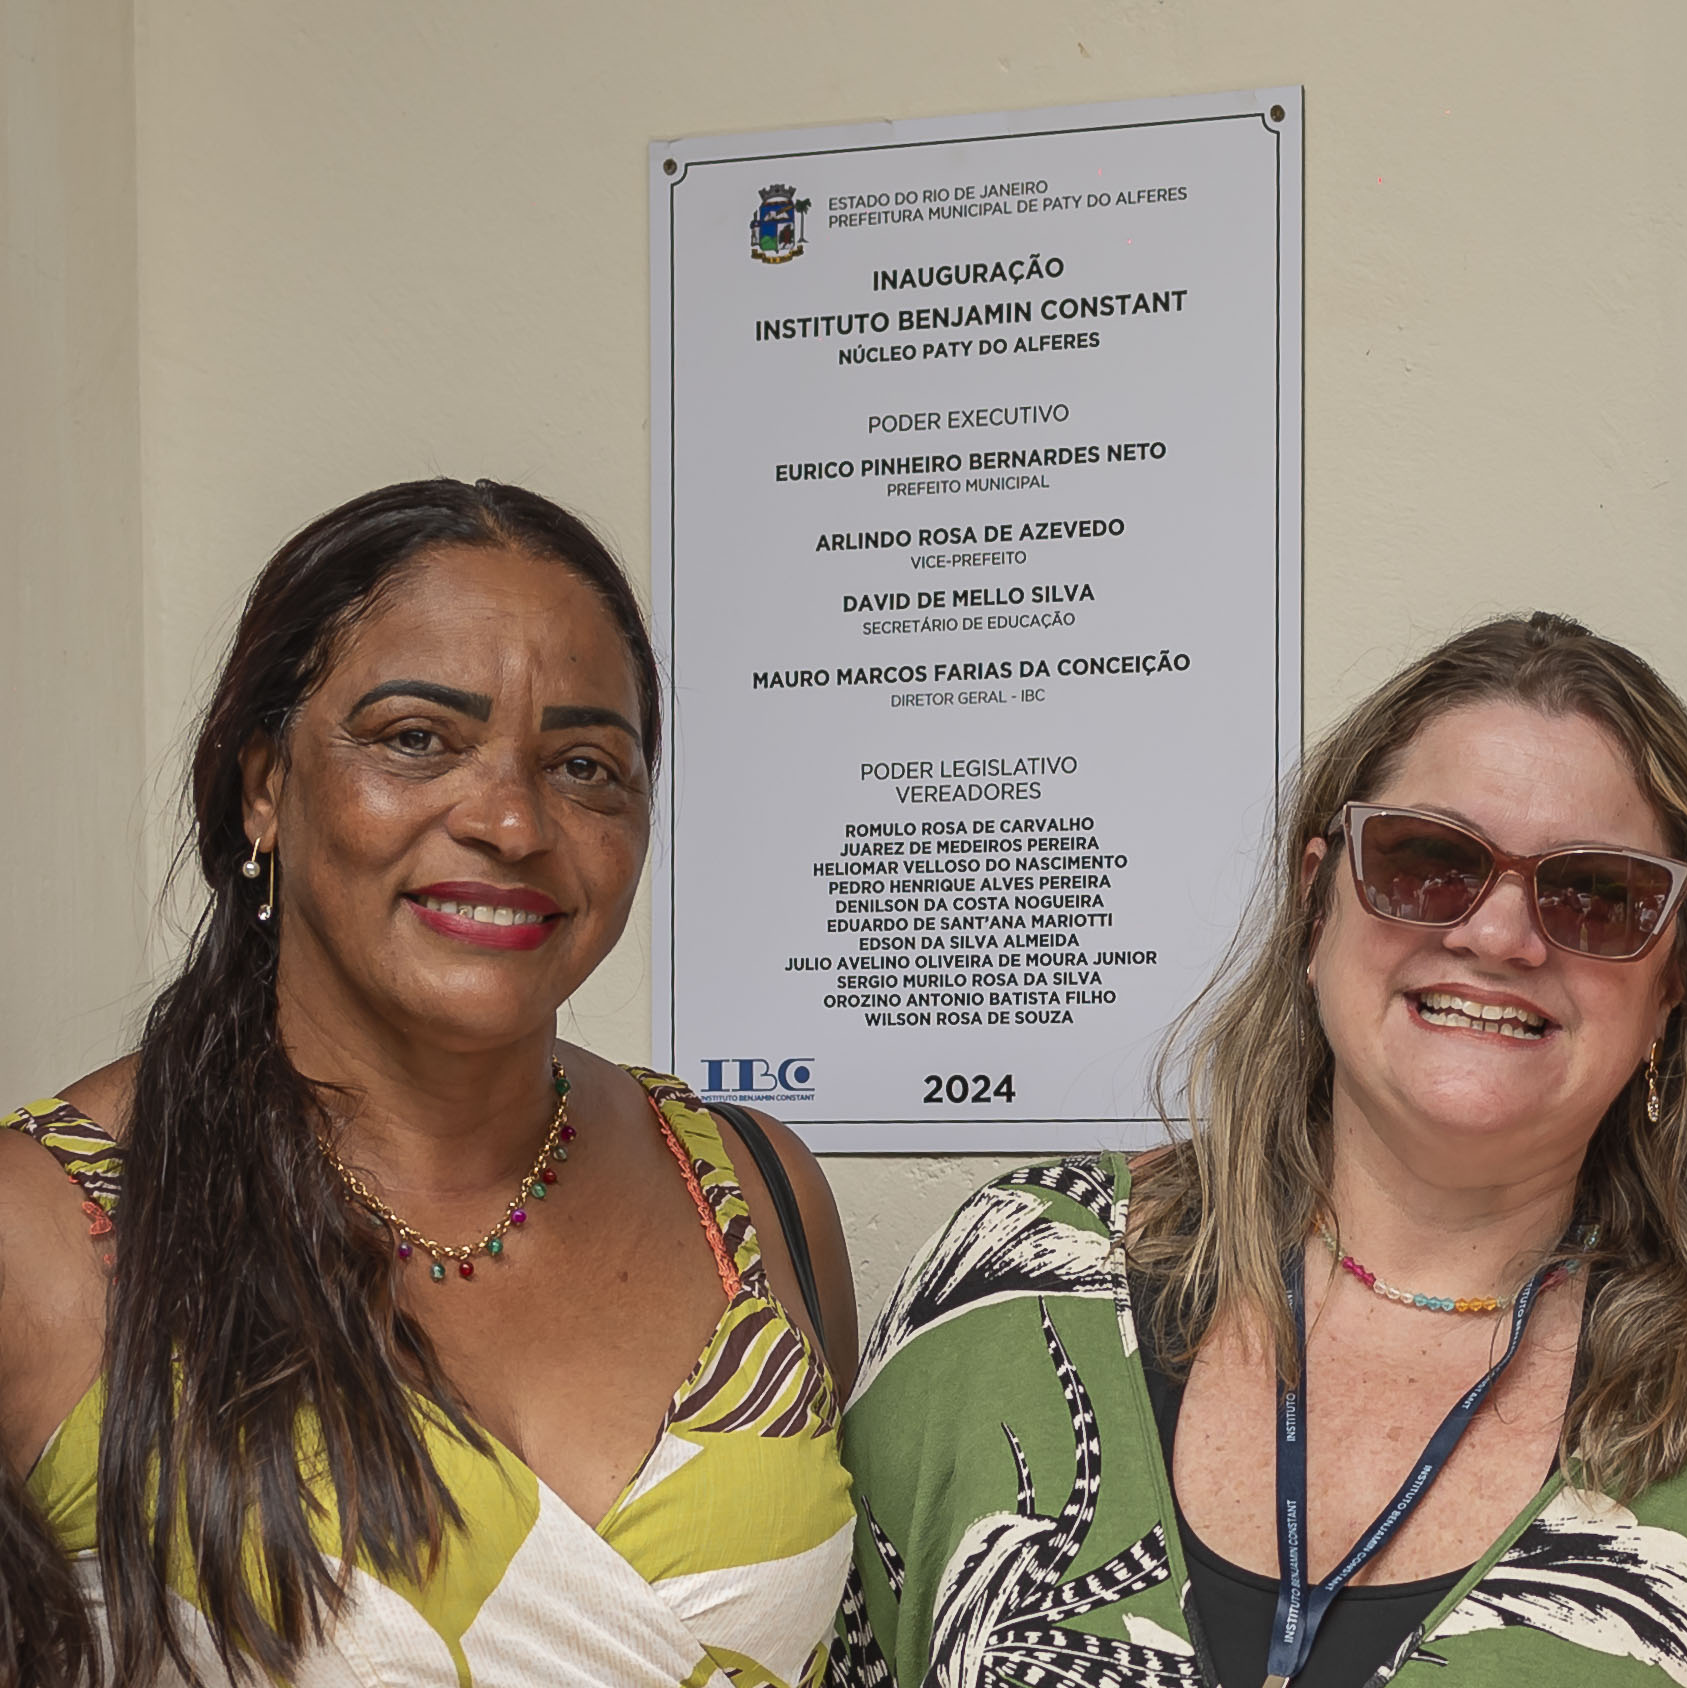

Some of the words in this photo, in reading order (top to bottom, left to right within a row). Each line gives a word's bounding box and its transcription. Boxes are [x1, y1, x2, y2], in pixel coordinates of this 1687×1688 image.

[828, 192, 891, 212] ESTADO
[894, 190, 919, 207] DO
[922, 187, 950, 204] RIO
[954, 185, 976, 201] DE
[979, 179, 1049, 199] JANEIRO
[828, 207, 925, 229] PREFEITURA
[928, 200, 1013, 221] MUNICIPAL
[1016, 197, 1039, 214] DE
[1042, 194, 1083, 212] PATY
[1086, 192, 1112, 208] DO
[1115, 186, 1188, 206] ALFERES
[873, 253, 1065, 292] INAUGURAÇÃO
[755, 311, 890, 342] INSTITUTO
[898, 300, 1032, 332] BENJAMIN
[1040, 289, 1188, 321] CONSTANT
[838, 343, 917, 366] NÚCLEO
[922, 339, 974, 360] PATY
[978, 338, 1008, 356] DO
[1012, 331, 1101, 354] ALFERES
[868, 412, 942, 435] PODER
[947, 403, 1070, 430] EXECUTIVO
[775, 460, 855, 483] EURICO
[860, 453, 962, 478] PINHEIRO
[968, 445, 1101, 471] BERNARDES
[1107, 441, 1167, 463] NETO
[886, 479, 962, 498] PREFEITO
[965, 474, 1050, 493] MUNICIPAL
[815, 529, 912, 553] ARLINDO
[918, 525, 978, 547] ROSA
[984, 523, 1013, 544] DE
[1018, 518, 1125, 542] AZEVEDO
[910, 550, 1027, 570] VICE-PREFEITO
[843, 592, 911, 613] DAVID
[917, 590, 946, 610] DE
[952, 586, 1025, 608] MELLO
[1031, 583, 1096, 604] SILVA
[862, 615, 959, 636] SECRETÁRIO
[962, 615, 984, 631] DE
[987, 610, 1076, 630] EDUCAÇÃO
[752, 668, 830, 690] MAURO
[836, 664, 928, 687] MARCOS
[933, 660, 1013, 682] FARIAS
[1019, 659, 1051, 679] DA
[1056, 650, 1191, 677] CONCEIÇÃO
[890, 692, 955, 708] DIRETOR
[957, 689, 1008, 705] GERAL
[1020, 688, 1046, 703] IBC
[860, 761, 934, 782] PODER
[940, 755, 1078, 779] LEGISLATIVO
[895, 781, 1042, 804] VEREADORES
[845, 821, 917, 839] ROMULO
[921, 820, 968, 837] ROSA
[972, 819, 996, 835] DE
[999, 816, 1095, 834] CARVALHO
[839, 841, 905, 858] JUAREZ
[909, 840, 933, 856] DE
[936, 838, 1023, 855] MEDEIROS
[1027, 835, 1100, 852] PEREIRA
[813, 860, 899, 877] HELIOMAR
[902, 858, 981, 875] VELLOSO
[985, 857, 1011, 873] DO
[1015, 854, 1128, 872] NASCIMENTO
[828, 879, 886, 896] PEDRO
[889, 877, 976, 894] HENRIQUE
[979, 876, 1035, 892] ALVES
[1038, 874, 1112, 891] PEREIRA
[835, 897, 919, 914] DENILSON
[923, 896, 949, 912] DA
[952, 895, 1011, 912] COSTA
[1014, 893, 1105, 910] NOGUEIRA
[826, 917, 909, 933] EDUARDO
[913, 916, 937, 932] DE
[1031, 912, 1113, 929] MARIOTTI
[858, 935, 917, 952] EDSON
[920, 935, 946, 950] DA
[949, 934, 999, 950] SILVA
[1002, 932, 1080, 949] ALMEIDA
[784, 956, 833, 972] JULIO
[836, 955, 911, 971] AVELINO
[914, 953, 994, 970] OLIVEIRA
[998, 953, 1022, 968] DE
[1025, 951, 1089, 968] MOURA
[1092, 950, 1158, 966] JUNIOR
[836, 974, 899, 990] SERGIO
[902, 973, 968, 989] MURILO
[971, 972, 1019, 988] ROSA
[1023, 971, 1049, 987] DA
[1052, 970, 1103, 986] SILVA
[823, 993, 902, 1009] OROZINO
[905, 991, 985, 1008] ANTONIO
[989, 990, 1061, 1006] BATISTA
[1065, 989, 1117, 1006] FILHO
[864, 1011, 932, 1027] WILSON
[936, 1010, 983, 1026] ROSA
[987, 1010, 1011, 1025] DE
[1014, 1009, 1074, 1025] SOUZA
[700, 1057, 816, 1093] IBC
[922, 1073, 1017, 1104] 2024
[738, 1094, 776, 1102] BENJAMIN
[776, 1093, 816, 1102] CONSTANT
[1285, 1392, 1297, 1442] INSTITUTO
[1397, 1464, 1433, 1511] INSTITUTO
[1286, 1499, 1299, 1546] CONSTANT
[1363, 1510, 1401, 1553] BENJAMIN
[1288, 1546, 1300, 1589] BENJAMIN
[1325, 1552, 1367, 1592] CONSTANT
[1283, 1588, 1301, 1644] INSTITUTO
